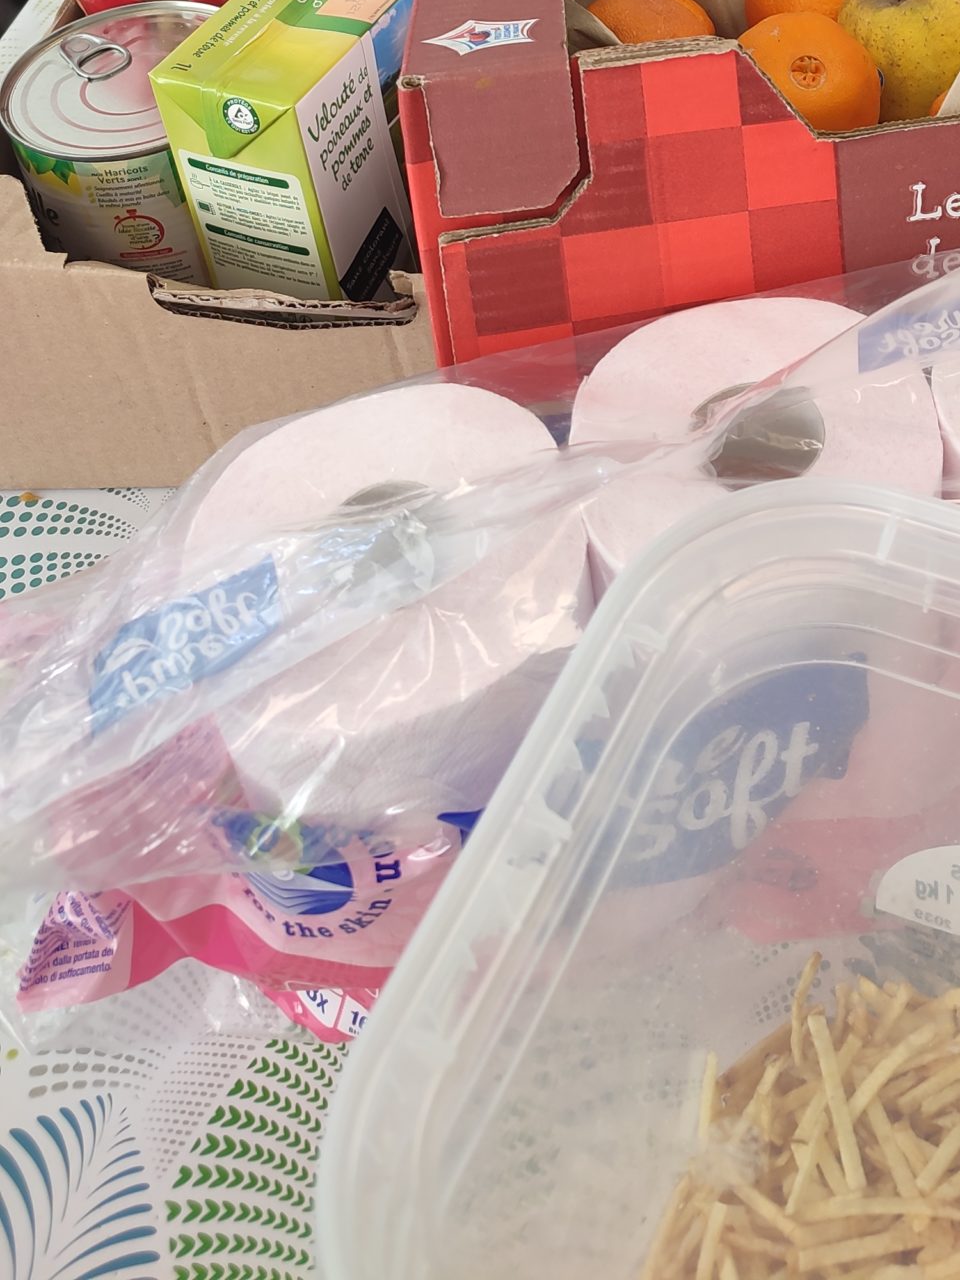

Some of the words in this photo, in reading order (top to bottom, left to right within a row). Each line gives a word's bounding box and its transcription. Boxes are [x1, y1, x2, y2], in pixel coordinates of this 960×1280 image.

[248, 0, 258, 11] et
[220, 5, 250, 35] pommes
[210, 32, 223, 43] de
[192, 39, 214, 58] terre
[308, 71, 356, 143] Velouté
[358, 65, 369, 85] de
[319, 101, 364, 171] poireaux
[363, 82, 373, 103] et
[331, 115, 371, 182] pommes
[104, 166, 149, 177] Haricots
[341, 173, 352, 192] de
[350, 136, 375, 175] terre
[97, 176, 125, 185] Verts
[282, 920, 333, 938] the
[339, 898, 393, 934] skin
[53, 955, 72, 966] dalla
[73, 950, 100, 964] portata
[50, 972, 57, 982] di
[58, 963, 112, 980] soffocamento.
